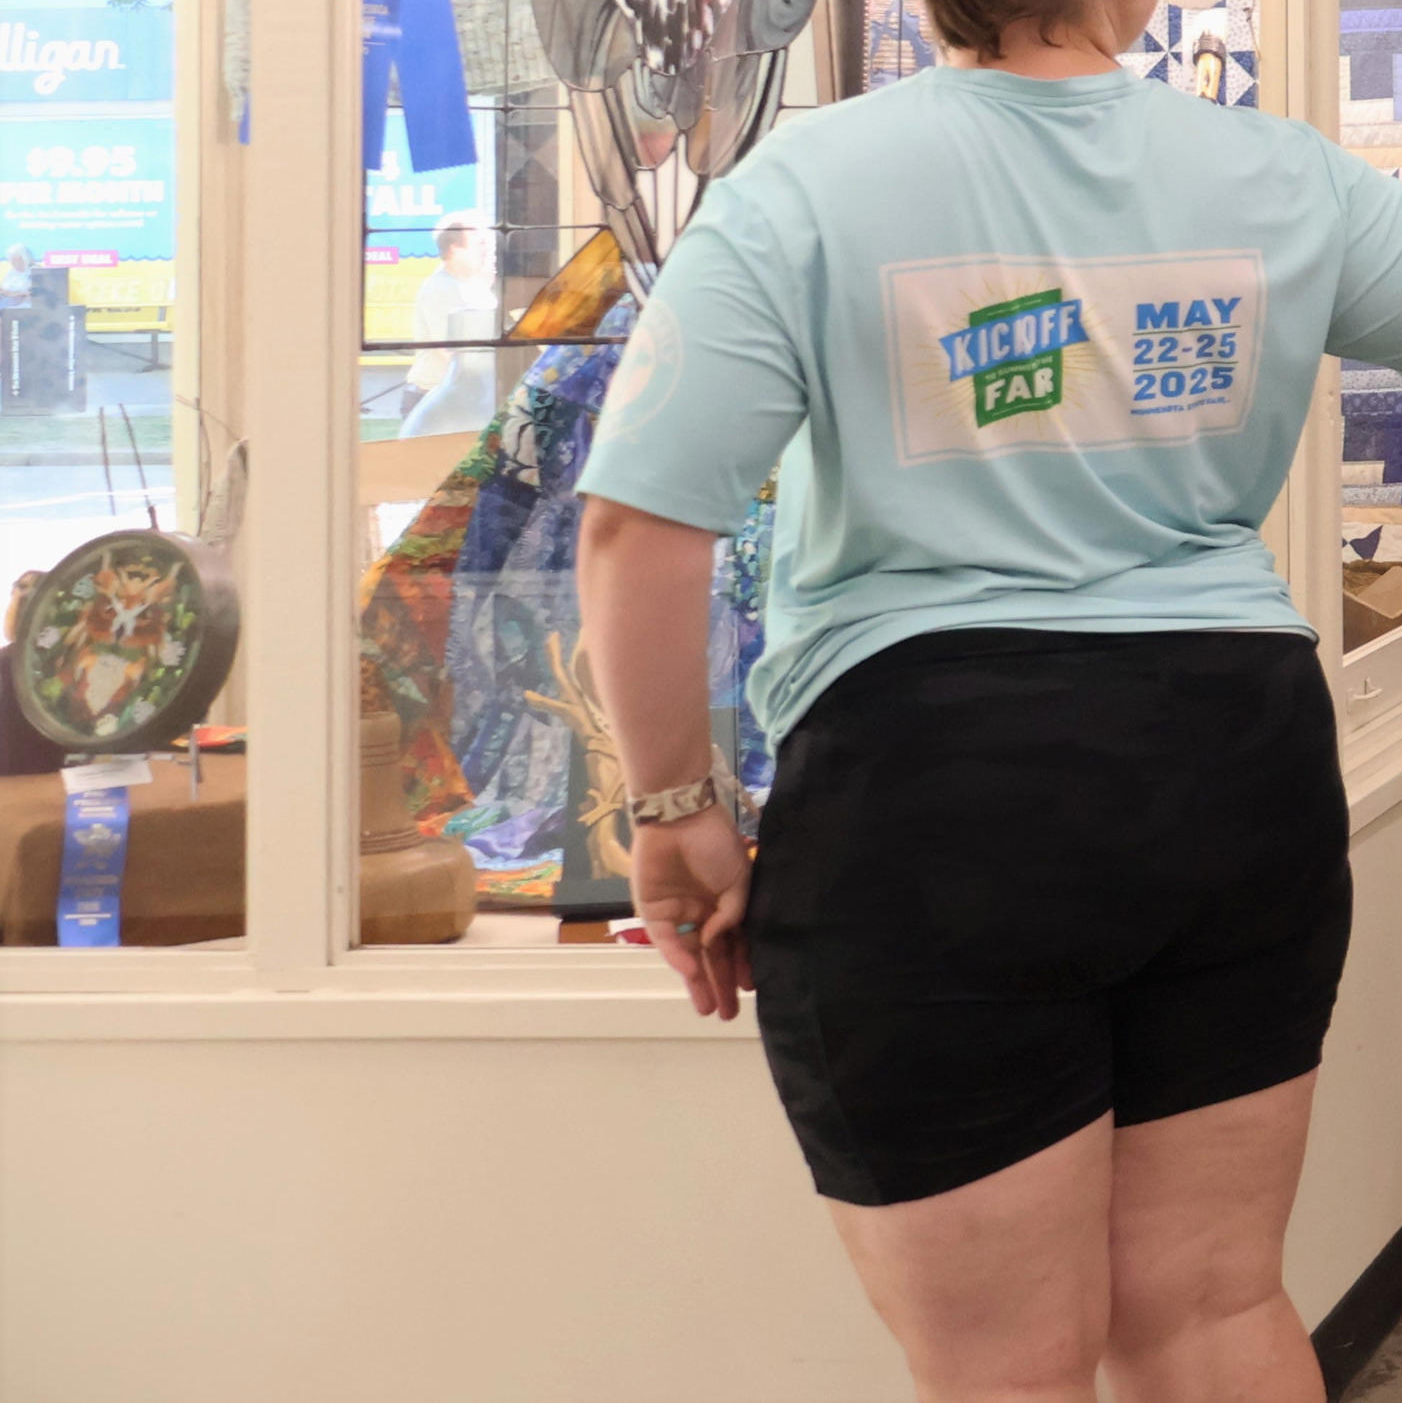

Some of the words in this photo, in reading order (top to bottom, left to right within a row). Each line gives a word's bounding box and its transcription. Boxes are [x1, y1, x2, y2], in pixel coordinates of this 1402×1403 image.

[1136, 297, 1242, 330] MAY
[1133, 332, 1237, 365] 22-25
[1133, 366, 1236, 401] 2025
